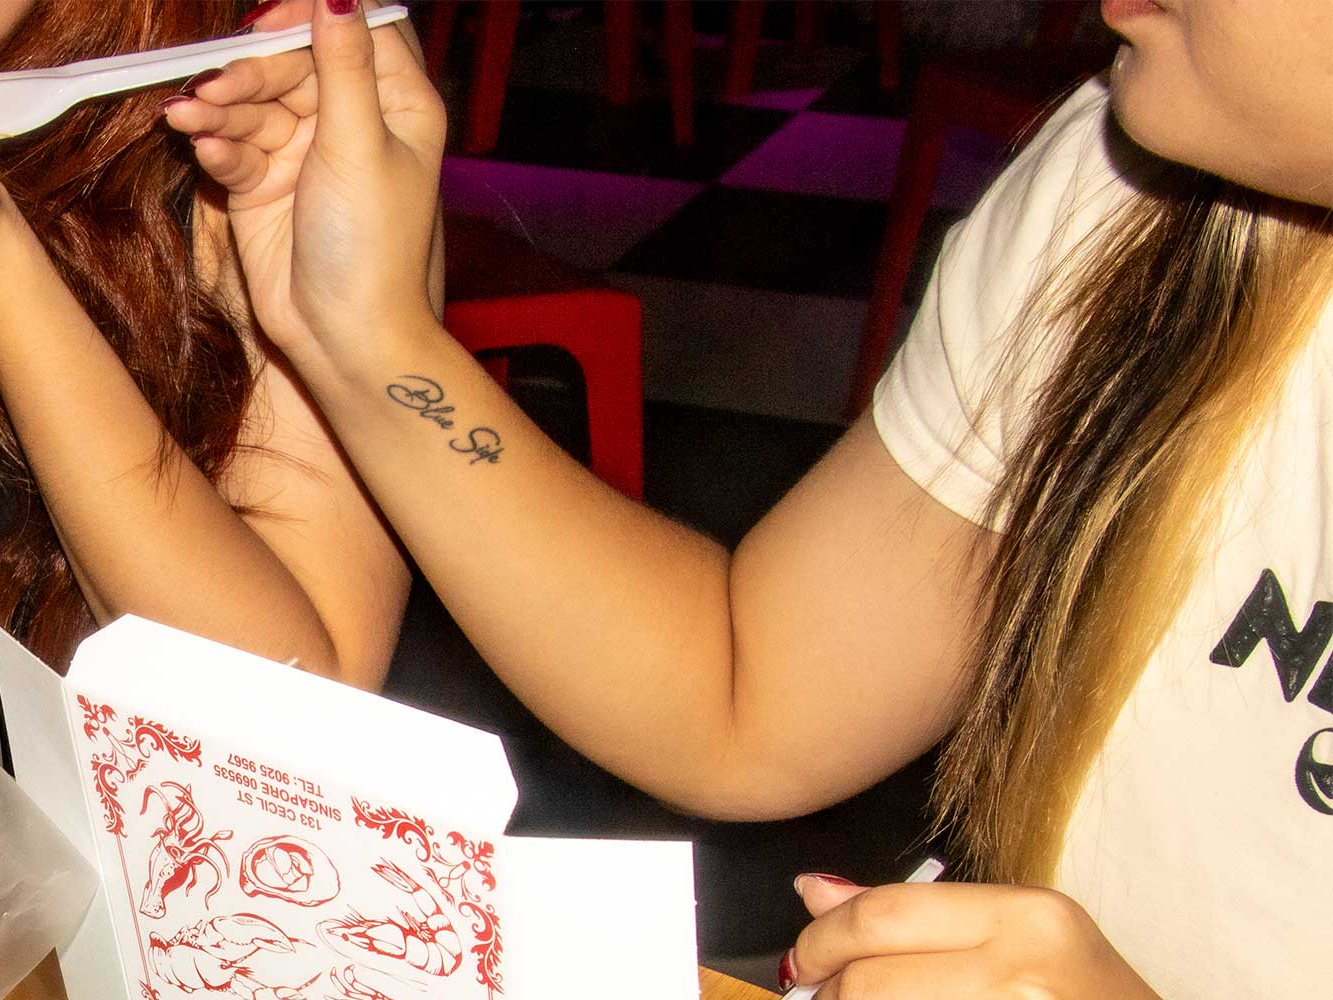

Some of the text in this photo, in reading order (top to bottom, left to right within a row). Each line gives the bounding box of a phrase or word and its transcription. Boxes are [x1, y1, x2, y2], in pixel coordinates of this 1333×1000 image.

[1209, 568, 1333, 714] N
[213, 764, 341, 821] SINGAPORE 069535
[227, 753, 324, 797] TEL: 9025 9567
[236, 789, 322, 830] 133 CECIL ST
